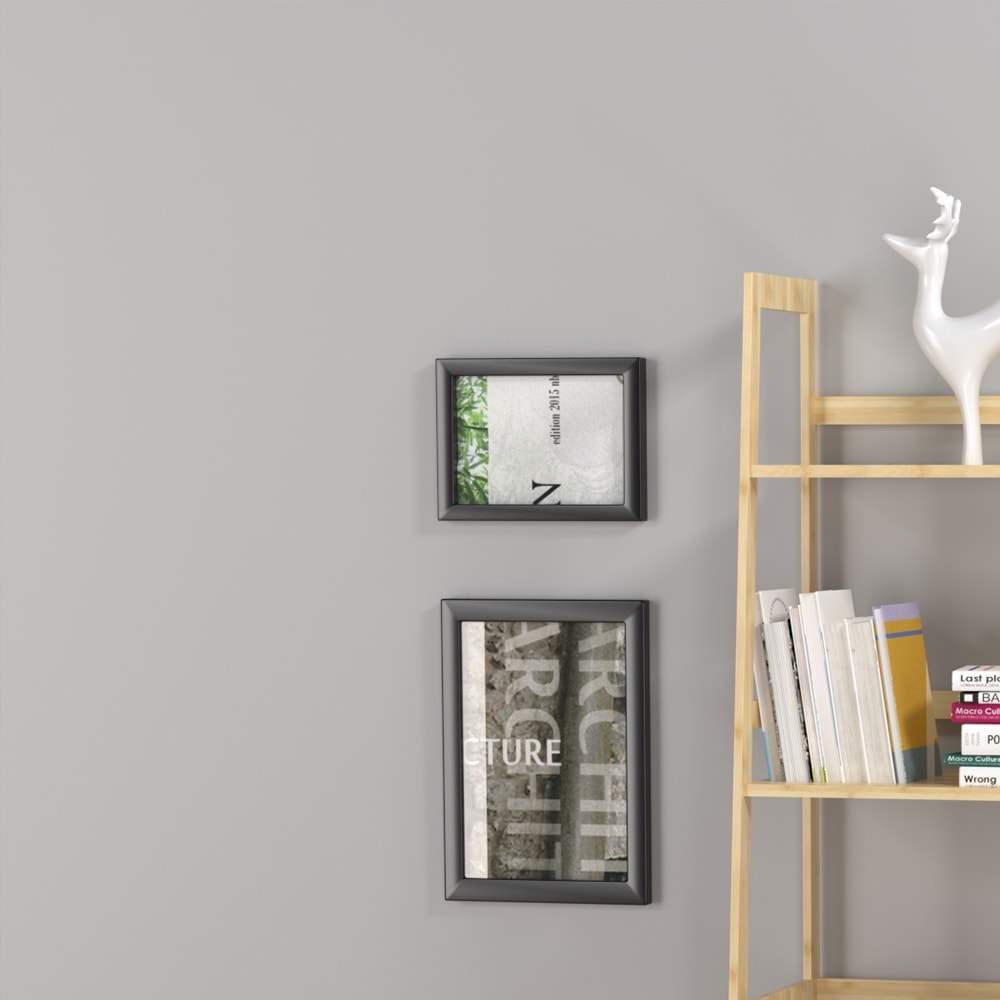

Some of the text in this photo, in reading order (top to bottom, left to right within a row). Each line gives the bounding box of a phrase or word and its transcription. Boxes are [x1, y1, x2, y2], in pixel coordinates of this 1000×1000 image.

[549, 389, 560, 410] 2015
[550, 413, 560, 445] edition
[960, 674, 982, 683] Last
[955, 707, 983, 715] Macro
[964, 775, 997, 785] Wrong
